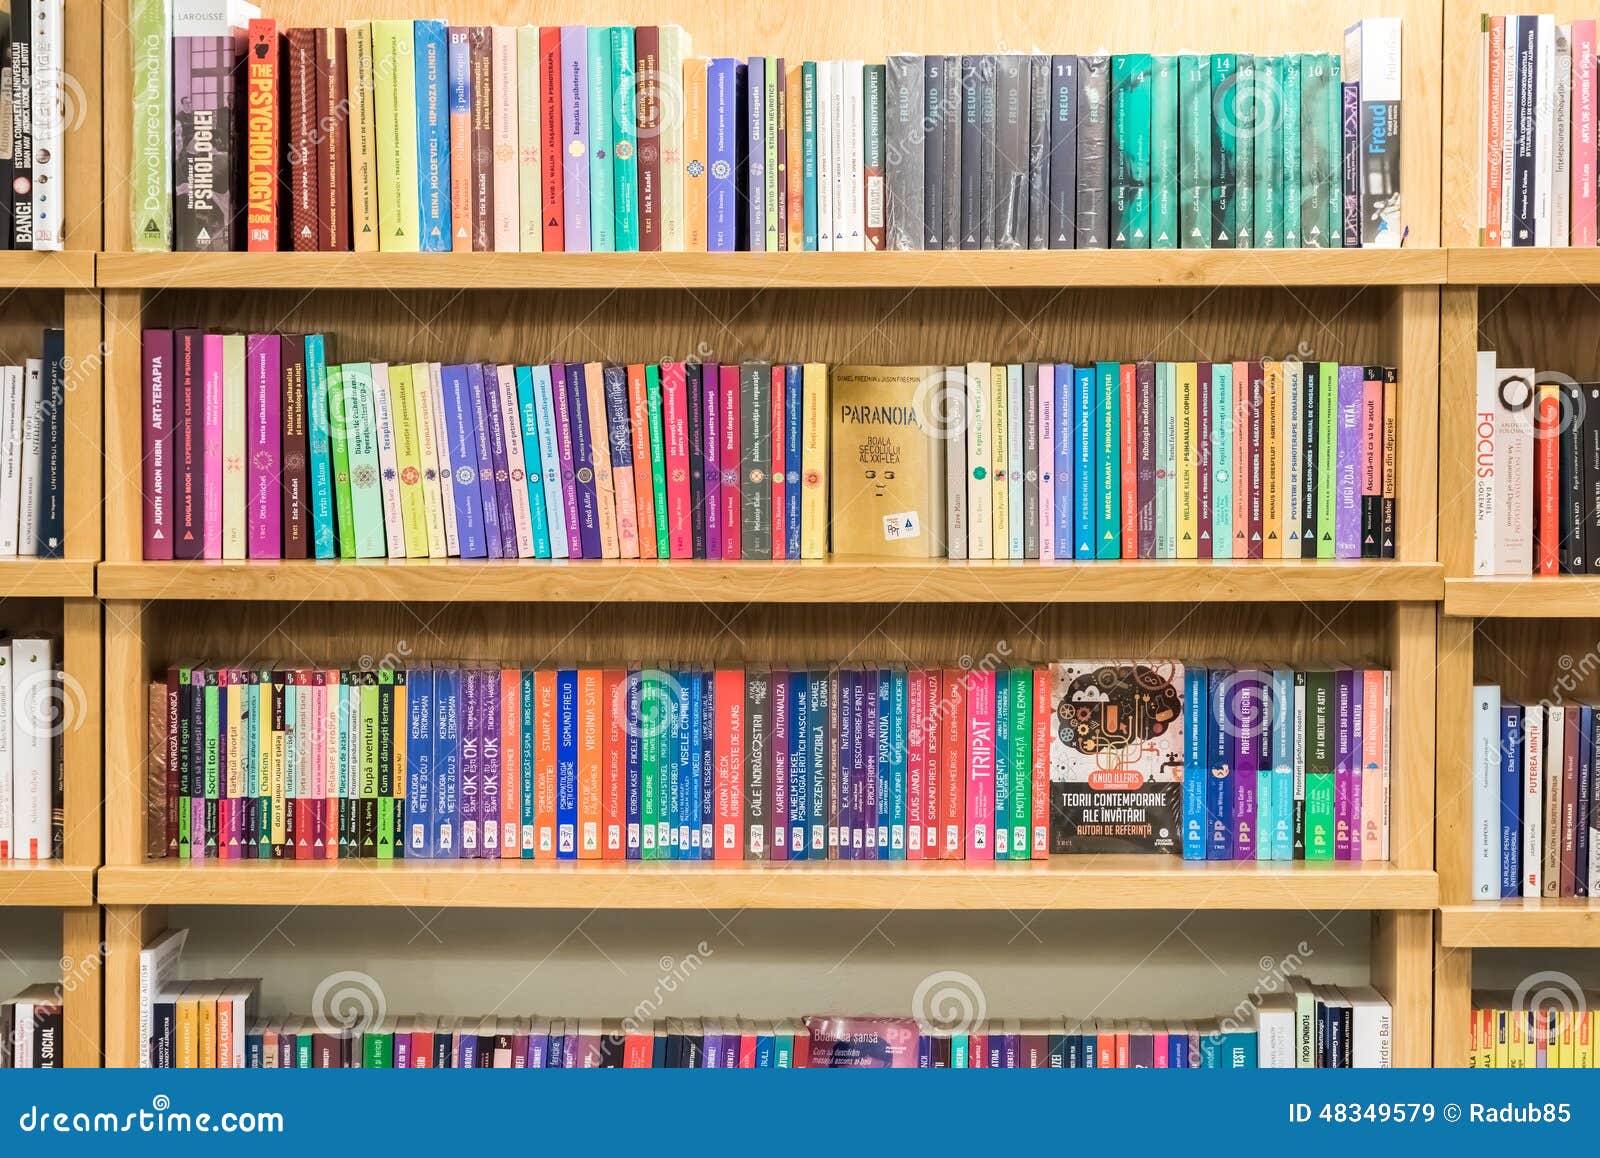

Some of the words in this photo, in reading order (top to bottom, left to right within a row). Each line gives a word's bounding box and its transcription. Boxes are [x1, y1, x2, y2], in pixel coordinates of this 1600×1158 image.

[179, 12, 224, 20] LAROUSSE
[452, 33, 467, 43] BP
[12, 42, 21, 90] UNIVERSULUI
[144, 34, 160, 99] umană
[251, 64, 272, 78] THE
[1057, 65, 1072, 76] 11
[1118, 58, 1125, 69] 7
[429, 84, 437, 125] HIPNOZA
[871, 72, 879, 136] PSIHOTERAPIEI
[900, 87, 908, 121] FREUD
[930, 88, 938, 123] FREUD
[968, 88, 976, 122] FREUD
[1009, 89, 1017, 123] FREUD
[1060, 87, 1068, 121] FREUD
[1369, 104, 1386, 153] Freud
[15, 140, 23, 168] ISTORIA
[144, 104, 160, 210] Dezvoltarea
[250, 79, 272, 211] PSYCHOLOGY
[871, 138, 879, 166] DARUL
[194, 110, 213, 209] PSIHOLOGIEI
[430, 138, 439, 188] HOLDEVICI
[250, 213, 271, 223] BOOK
[431, 193, 439, 218] IRINA
[16, 202, 32, 242] BANG!
[152, 356, 162, 429] ART-TERAPIA
[557, 380, 569, 422] protectoare
[524, 403, 536, 435] Isteria
[841, 405, 919, 426] PARANOIA
[154, 440, 162, 466] RUBIN
[562, 424, 571, 460] Carapacea
[858, 445, 900, 454] SECOLULUI
[867, 436, 891, 446] BOALA
[1478, 412, 1494, 478] FOCUS
[859, 454, 868, 463] AL
[870, 454, 900, 463] XXI-LEA
[318, 463, 326, 485] Yalom
[319, 498, 327, 516] Irvin
[584, 492, 592, 507] Adler
[569, 506, 577, 529] Frances
[585, 509, 594, 528] Alfred
[564, 683, 572, 710] FREUD
[585, 677, 595, 705] SATIR
[421, 696, 429, 739] STRONGMAN
[681, 687, 689, 729] COPIILOR
[732, 704, 740, 732] AJUNS
[777, 683, 785, 738] AUTOANALIZA
[181, 719, 189, 744] egoist
[412, 706, 420, 739] KENNETH
[542, 719, 551, 751] STUART
[564, 712, 572, 746] SIGMUND
[586, 709, 595, 750] VIRGINIA
[207, 738, 216, 765] toxici
[364, 717, 373, 763] aventură
[464, 737, 478, 758] OK
[681, 732, 689, 766] VISELE
[732, 734, 740, 744] DE
[813, 726, 823, 767] INVIZIBILĂ
[972, 717, 989, 780] TRIPAT
[180, 762, 188, 773] de
[261, 752, 269, 792] Charisma
[731, 747, 739, 769] ESTE
[776, 751, 784, 783] HORNEY
[207, 768, 216, 794] Socrii
[364, 766, 375, 793] După
[464, 775, 477, 795] OK
[731, 771, 739, 780] NU
[911, 769, 919, 795] JANDA
[928, 760, 936, 785] FREUD
[1093, 774, 1112, 787] KNUD
[1114, 774, 1138, 787] ILLERIS
[1530, 755, 1538, 793] PUTEREA
[731, 782, 740, 816] IUBIREA
[776, 785, 784, 813] KAREN
[867, 783, 875, 805] ERICH
[928, 786, 936, 820] SIGMUND
[1062, 793, 1092, 807] TEORII
[1094, 793, 1166, 807] CONTEMPORANE
[911, 797, 919, 820] LOUIS
[1083, 809, 1099, 822] ALE
[1077, 825, 1101, 836] AUTORI
[1104, 825, 1113, 836] DE
[1214, 820, 1225, 840] PP
[1240, 822, 1250, 842] PP
[1503, 878, 1510, 886] UN
[141, 996, 147, 1006] CU
[1302, 1014, 1310, 1044] FLORINDA
[1380, 1015, 1389, 1036] Bair
[42, 1027, 53, 1058] SOCIAL
